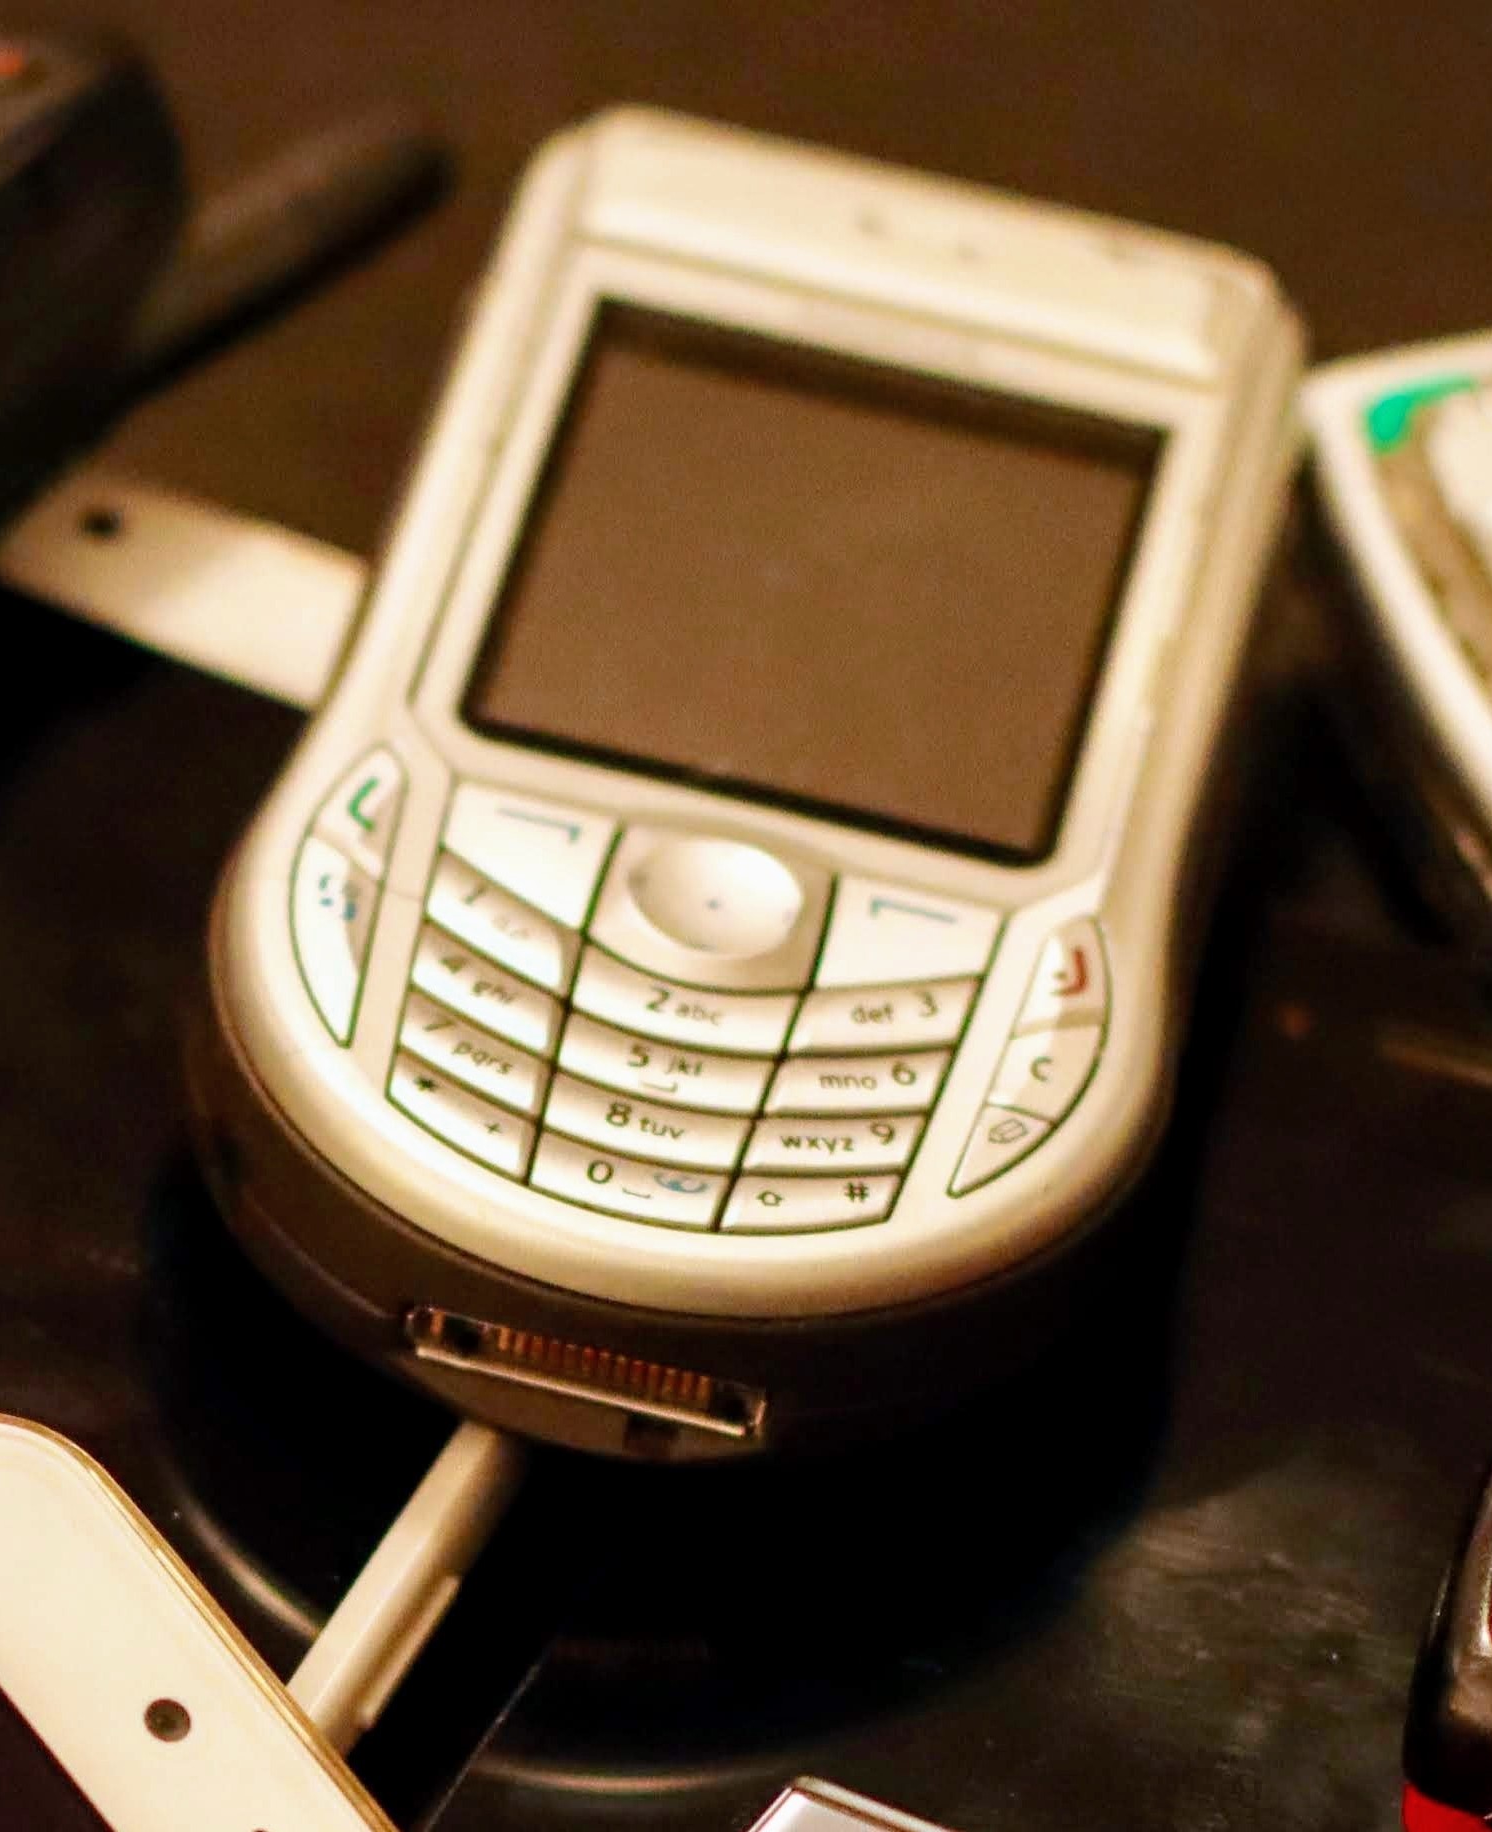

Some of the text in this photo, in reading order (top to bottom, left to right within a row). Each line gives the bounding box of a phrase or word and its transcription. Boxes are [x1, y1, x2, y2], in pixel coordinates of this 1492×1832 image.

[645, 987, 723, 1026] 2 abc
[915, 990, 939, 1018] 3
[452, 1041, 513, 1076] pqrs
[626, 1044, 651, 1068] 5
[818, 1061, 918, 1090] mno 6
[605, 1101, 685, 1141] 8 tuv
[780, 1119, 896, 1155] wxyz 9
[585, 1158, 615, 1186] 0
[843, 1180, 870, 1204] #
